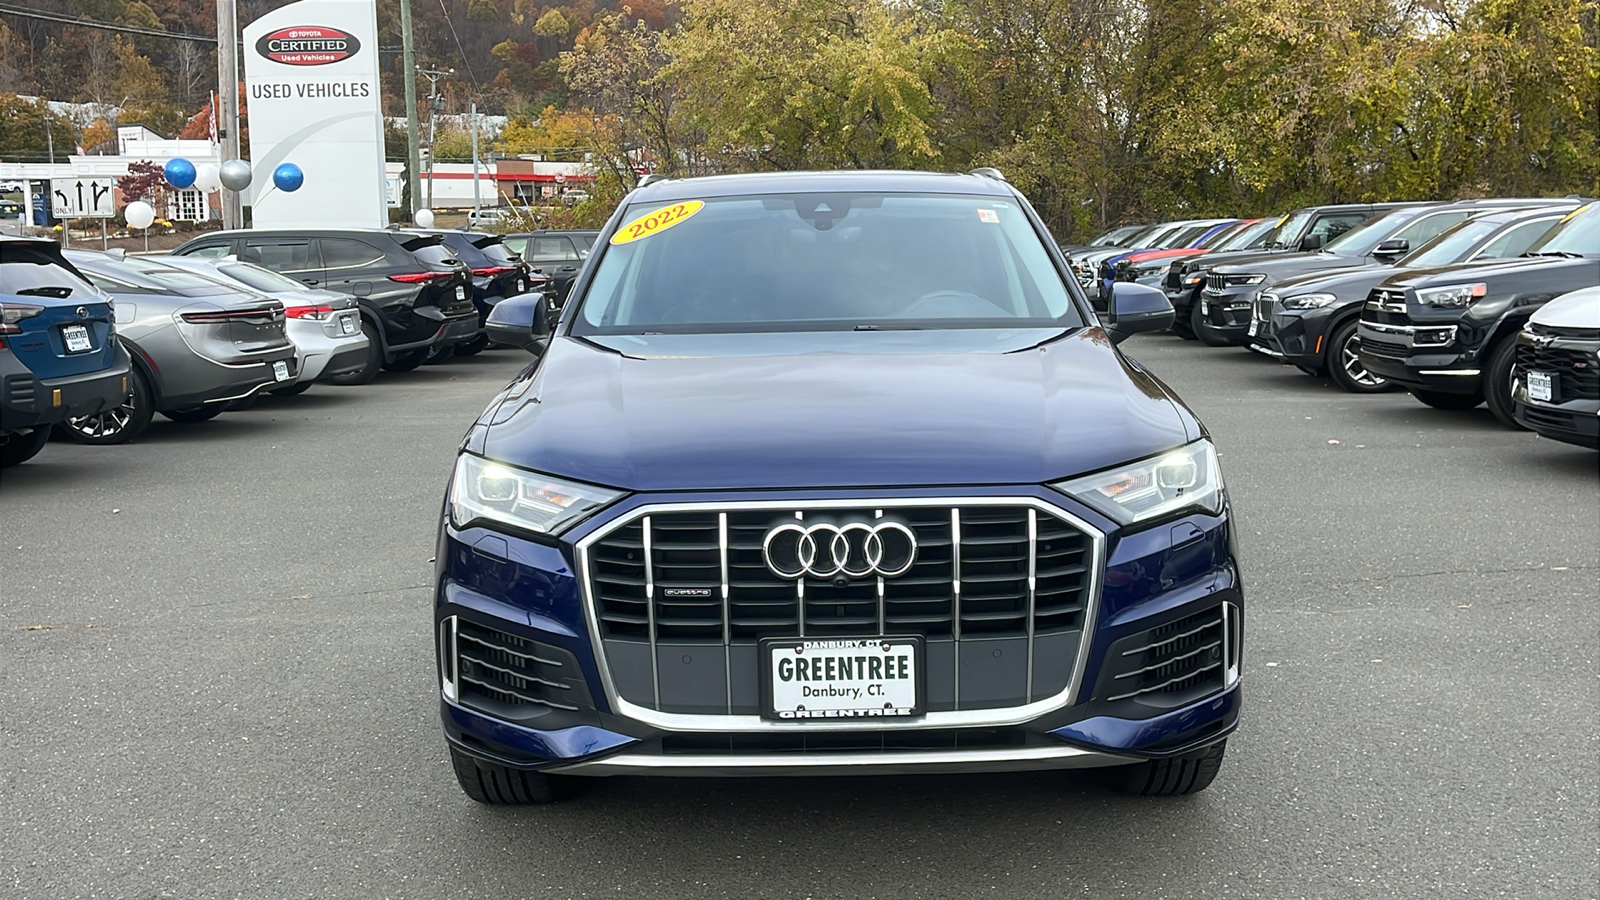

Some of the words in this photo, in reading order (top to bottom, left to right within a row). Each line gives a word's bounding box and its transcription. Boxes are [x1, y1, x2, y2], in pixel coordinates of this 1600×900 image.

[268, 39, 347, 52] CERTIFIED
[252, 83, 292, 99] USED
[296, 82, 369, 98] VEHICLES
[55, 207, 73, 215] ONLY
[628, 205, 689, 239] 2022
[803, 640, 863, 650] DANBURY,
[865, 639, 882, 648] CT
[778, 655, 909, 682] GREENTREE
[802, 685, 863, 700] Danbury,
[867, 684, 885, 696] CT.
[778, 708, 912, 719] GREENTREE
